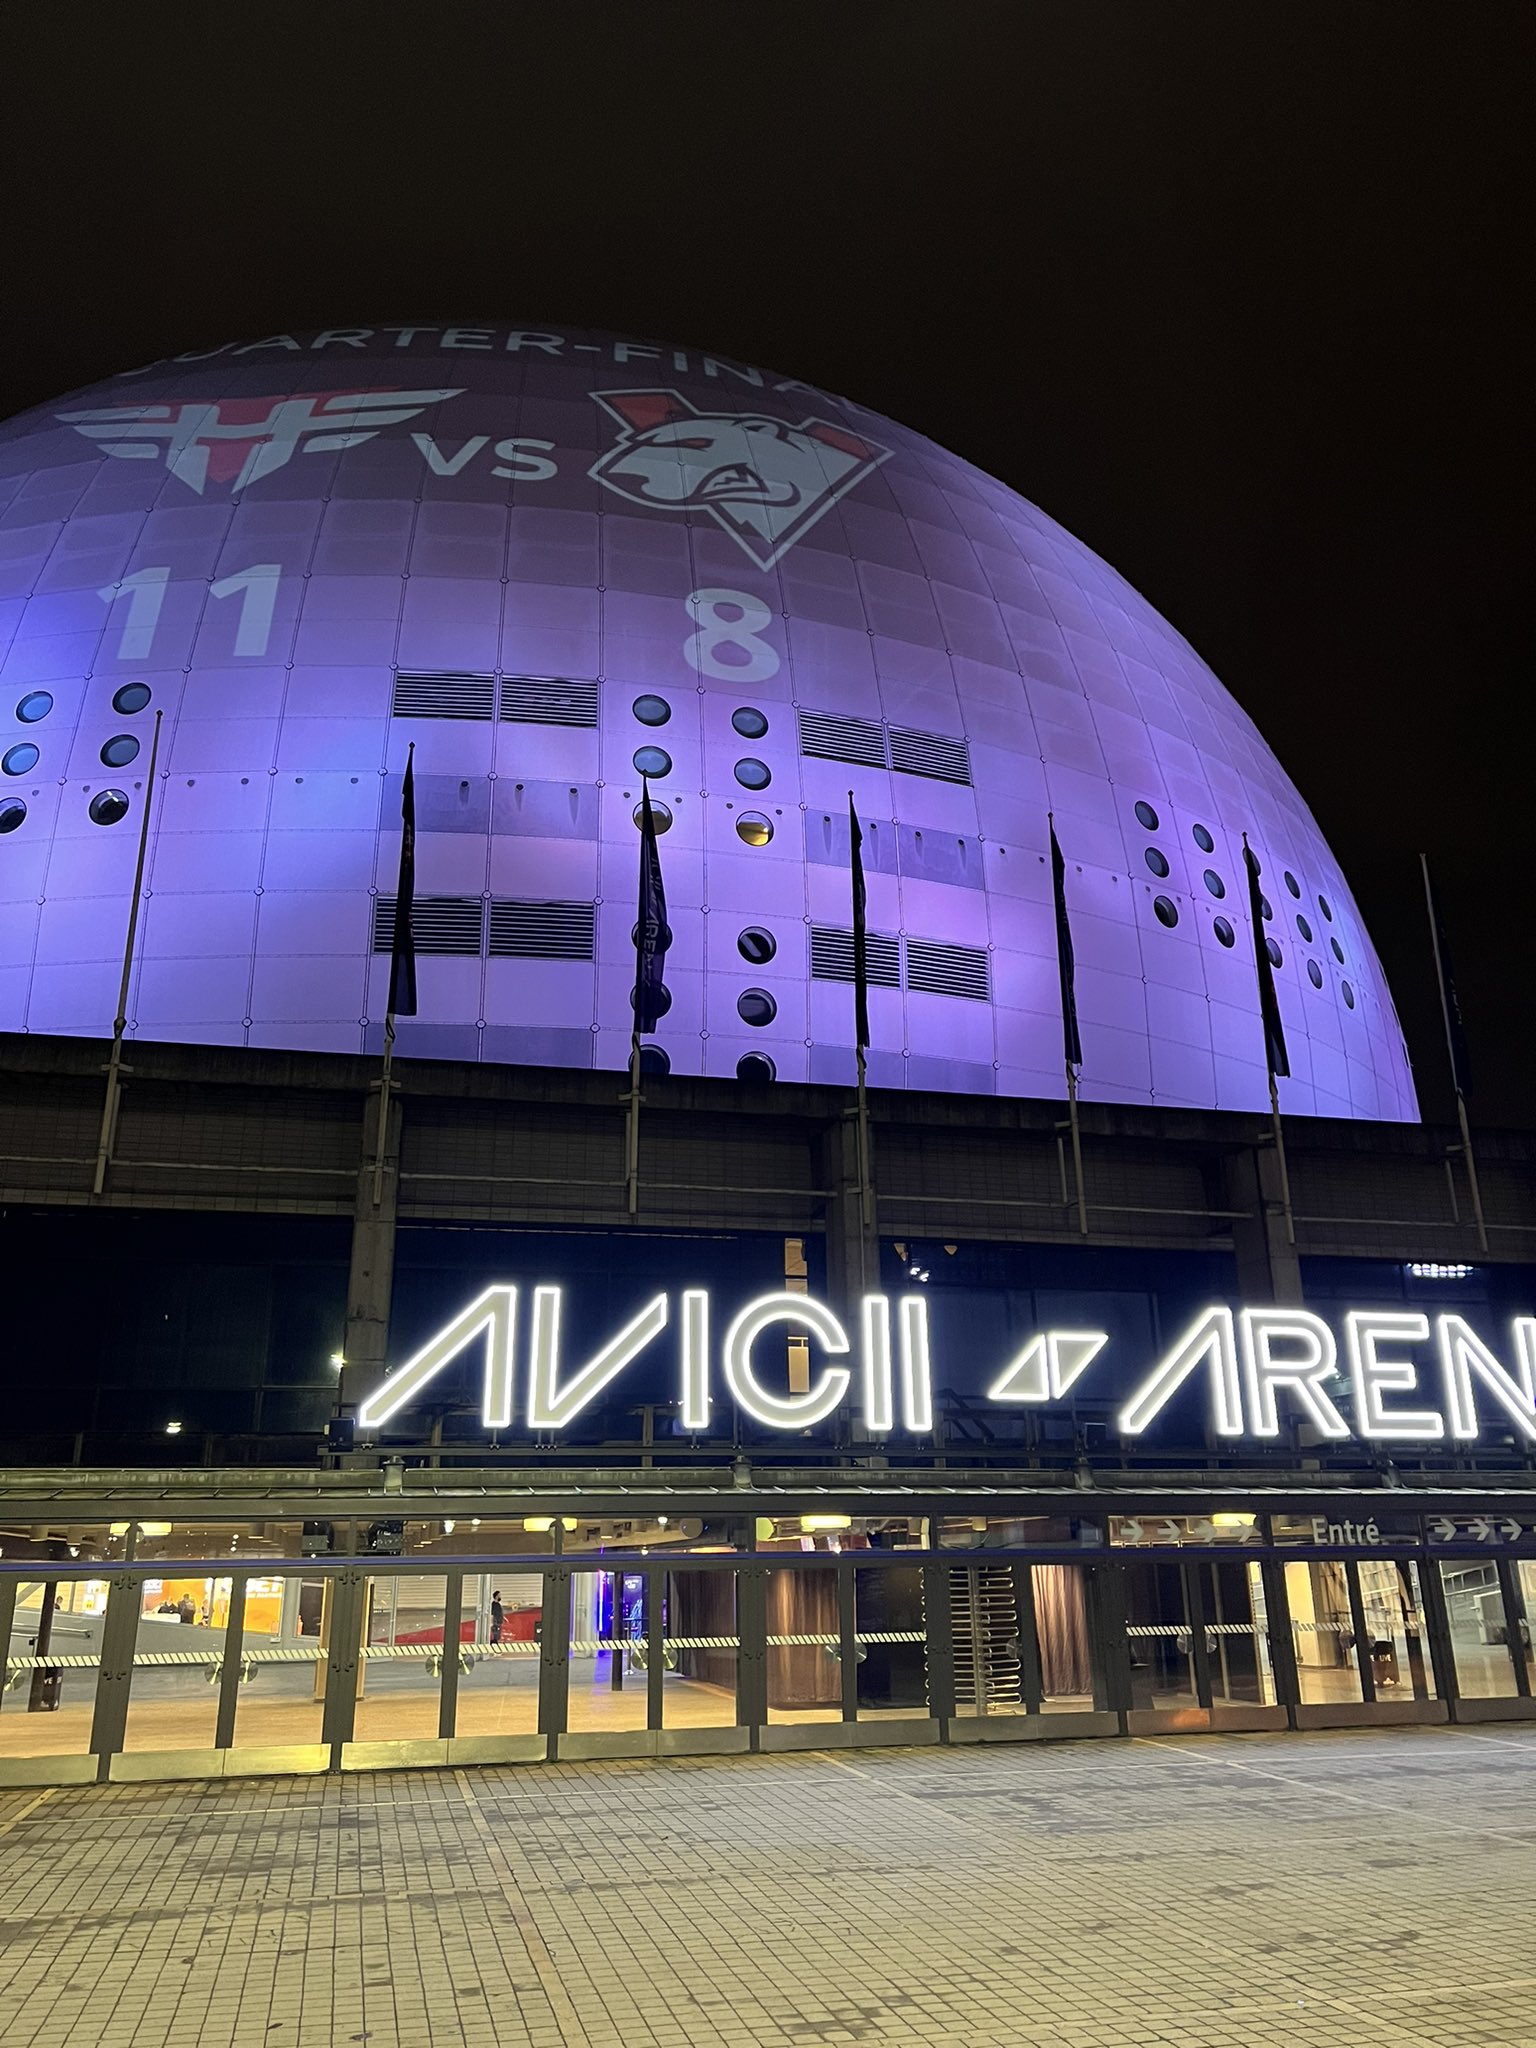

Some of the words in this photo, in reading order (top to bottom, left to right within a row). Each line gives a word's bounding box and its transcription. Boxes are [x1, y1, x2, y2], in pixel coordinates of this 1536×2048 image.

[410, 432, 558, 481] VS
[96, 564, 282, 660] 11
[683, 588, 780, 683] 8
[358, 1284, 934, 1433] AVICII
[1311, 1517, 1380, 1545] Entré
